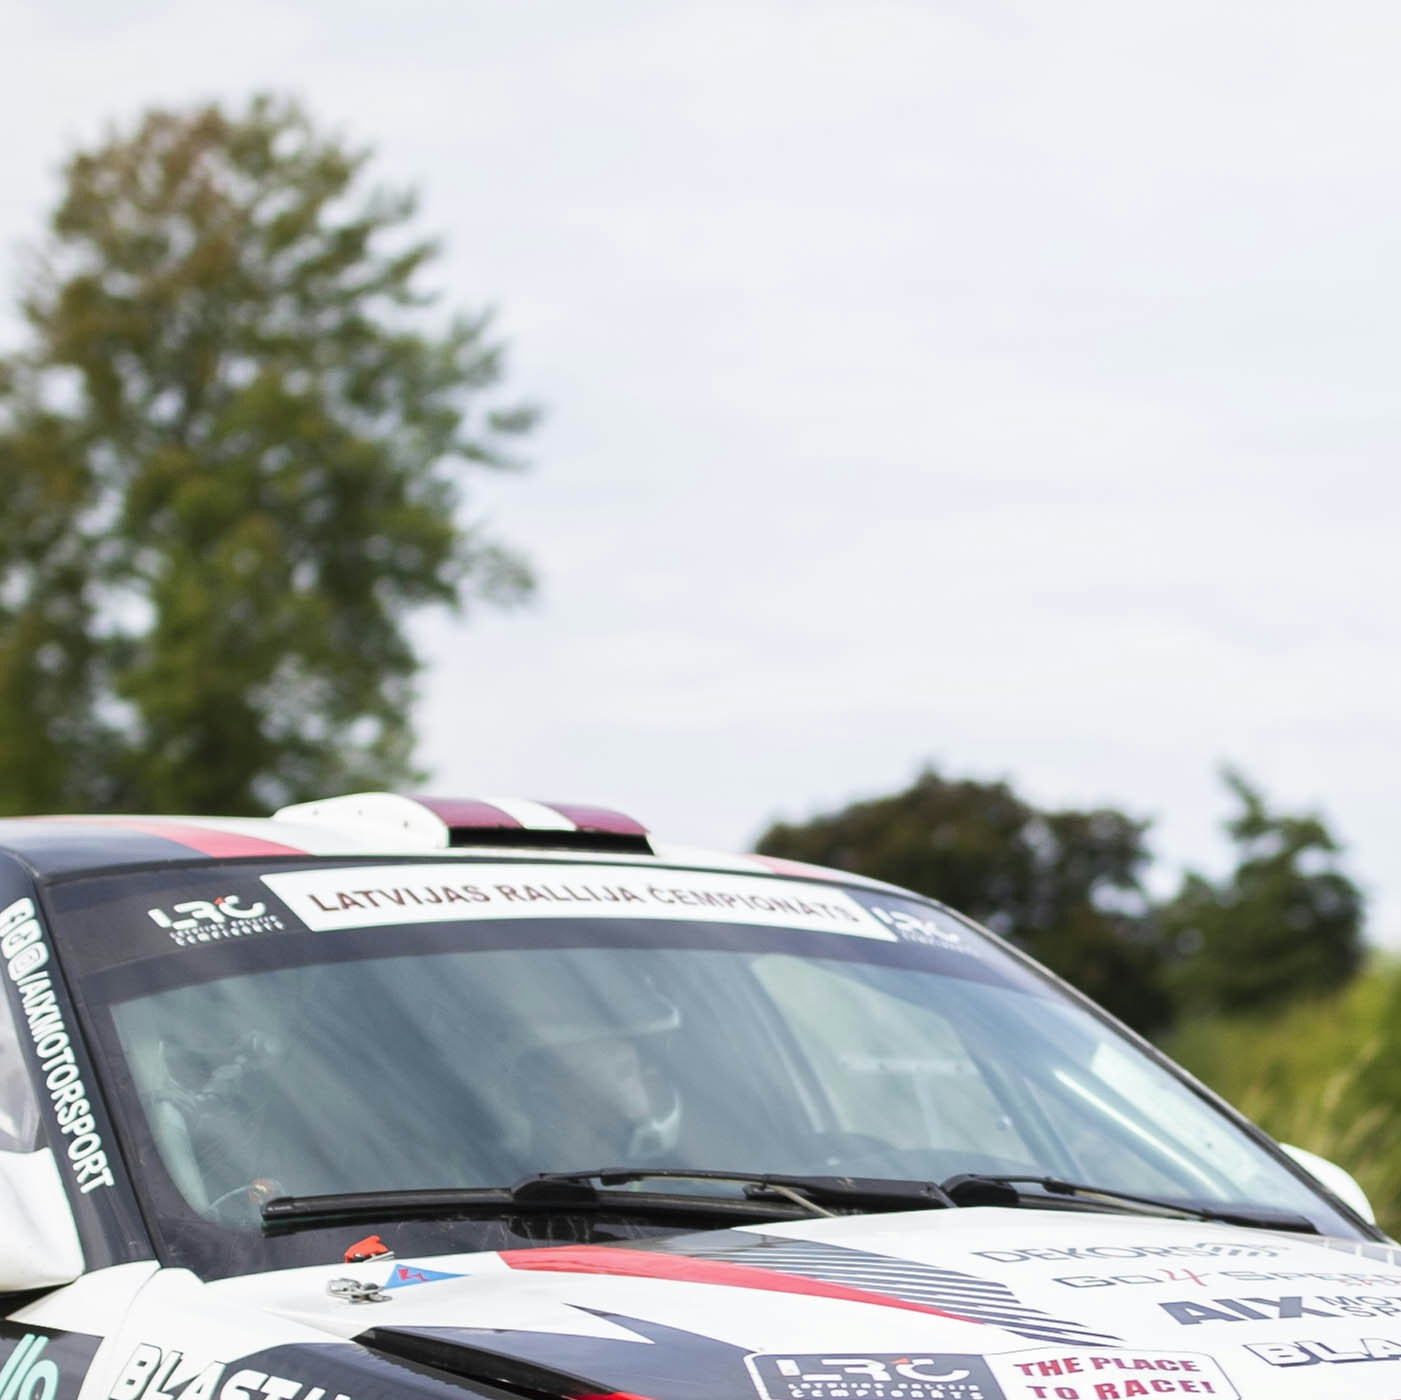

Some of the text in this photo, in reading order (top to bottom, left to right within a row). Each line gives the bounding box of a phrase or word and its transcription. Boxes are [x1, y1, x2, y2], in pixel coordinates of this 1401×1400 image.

[309, 885, 490, 912] LATVIJAS
[493, 884, 640, 904] RALLIJA
[1159, 1296, 1345, 1325] AIX
[1013, 1357, 1202, 1376] THE PLACE
[1026, 1379, 1216, 1400] TO RACE!
